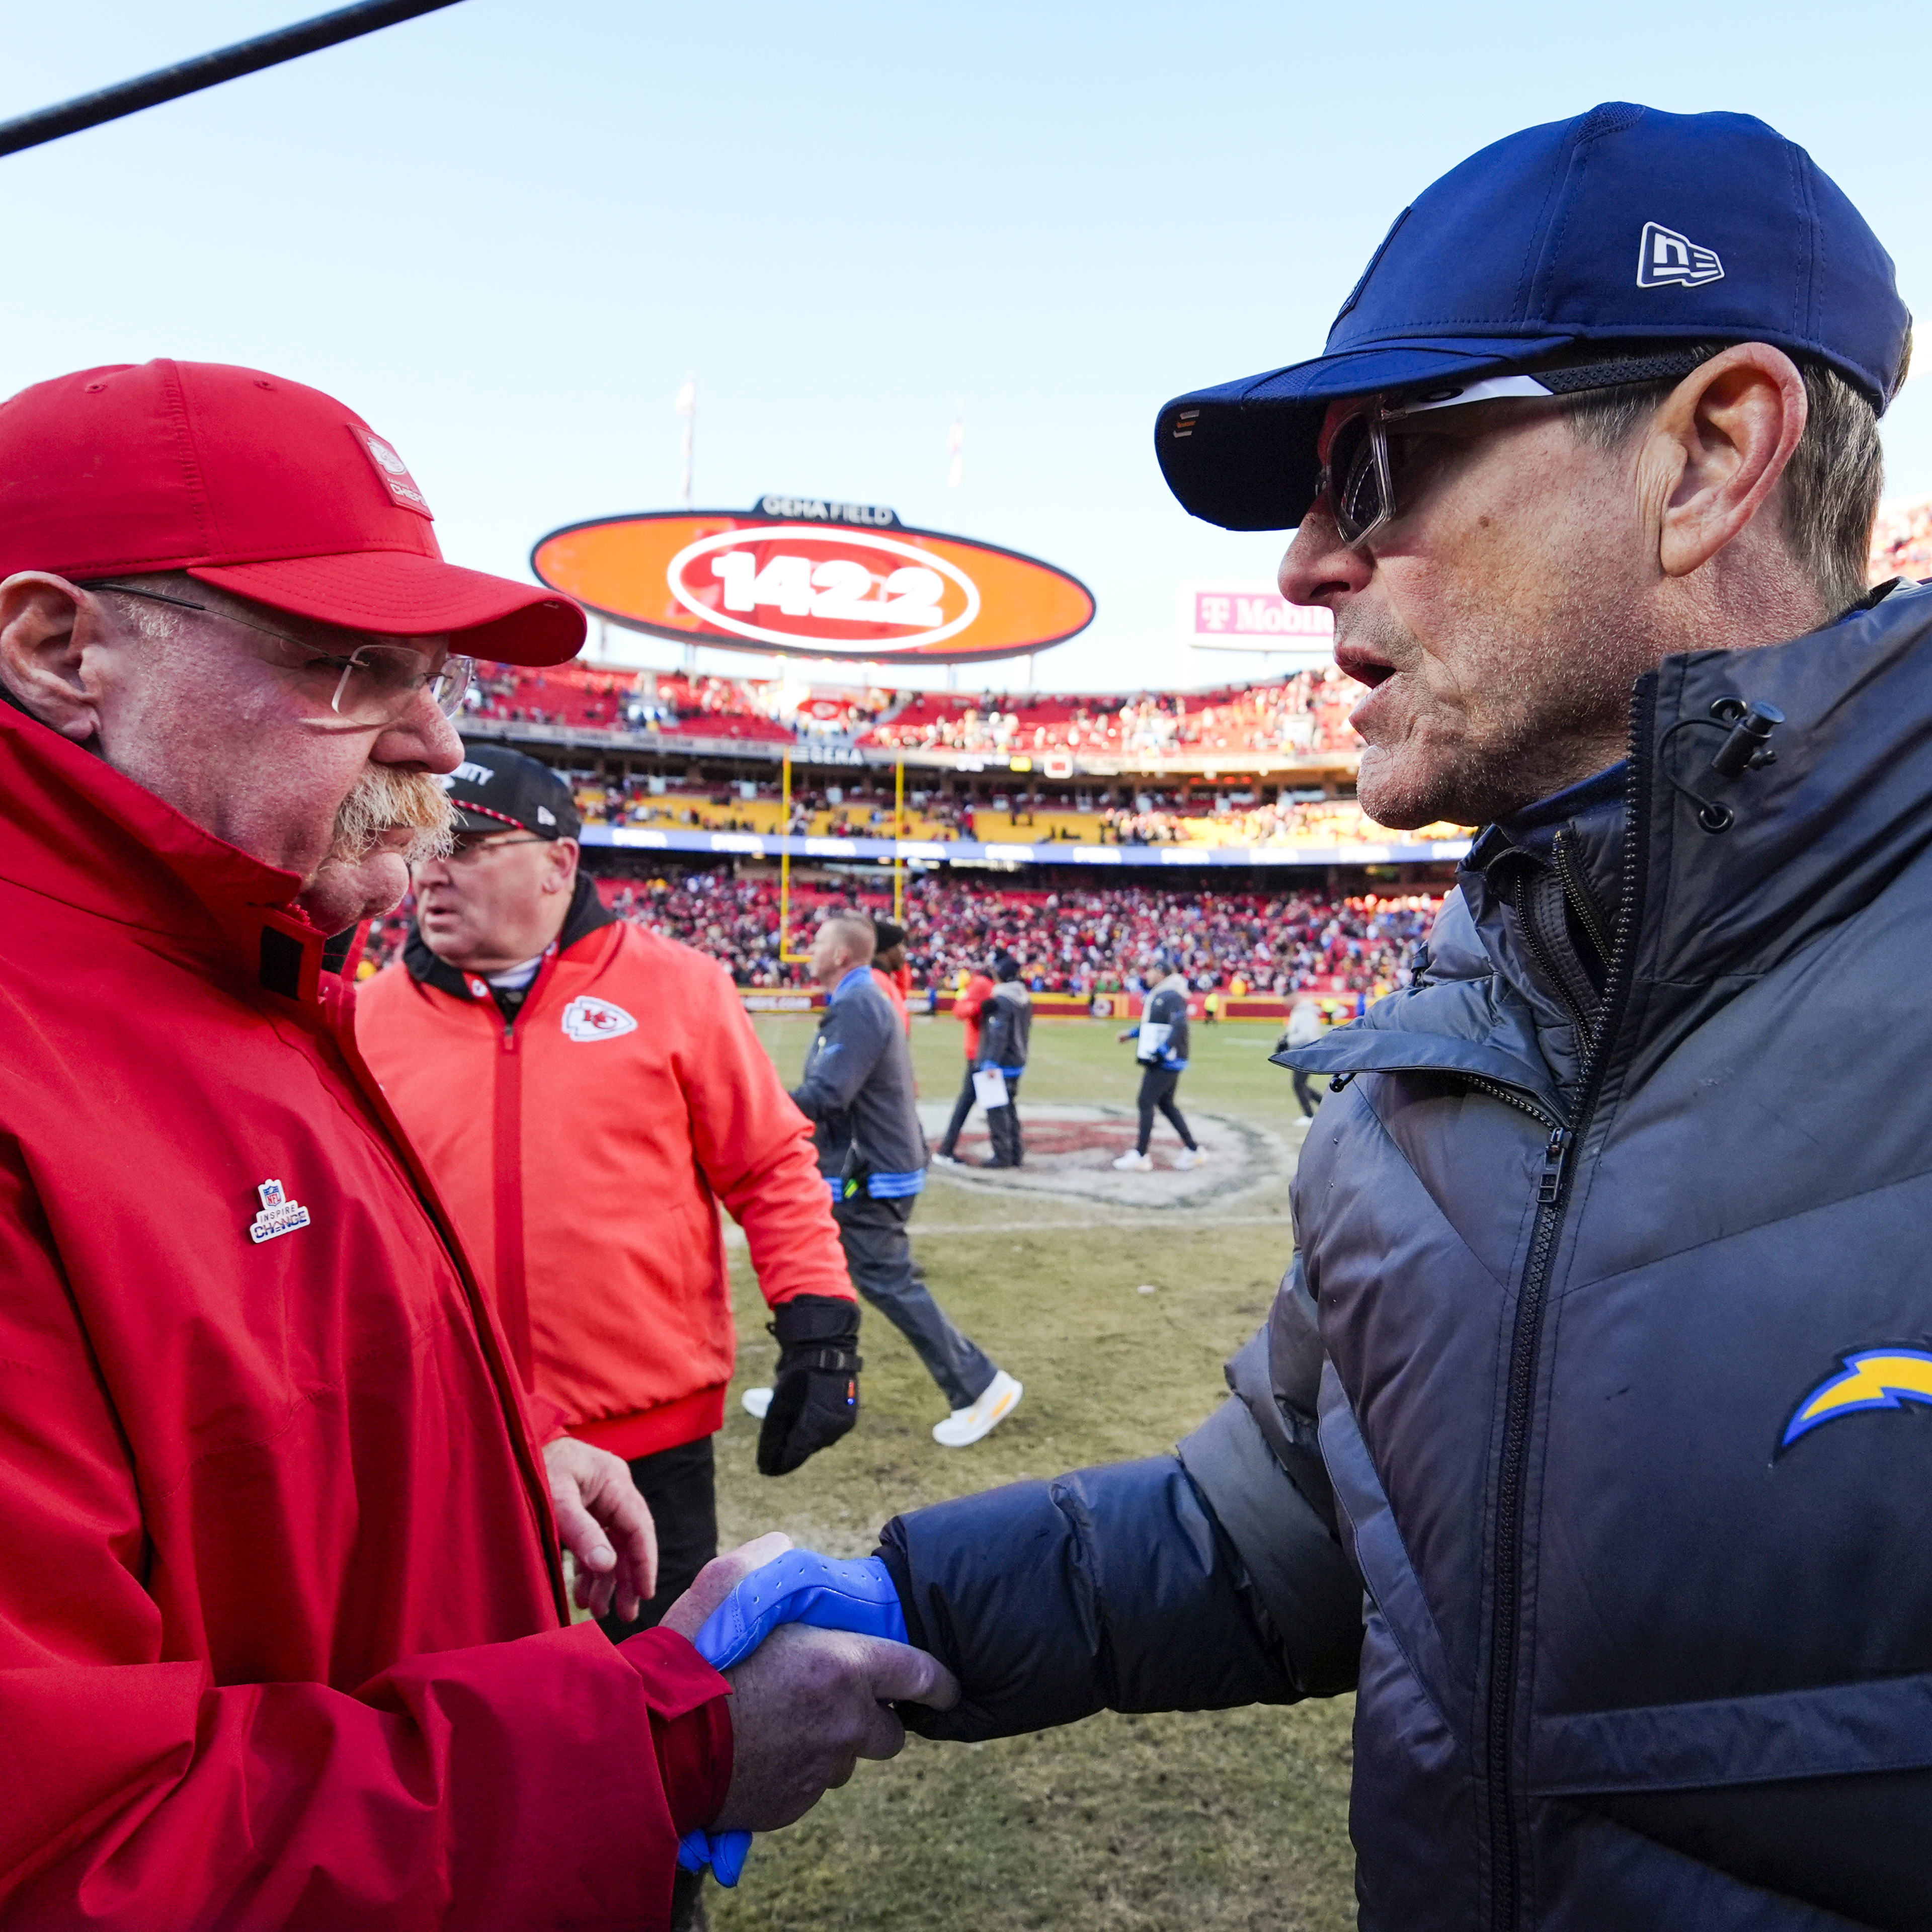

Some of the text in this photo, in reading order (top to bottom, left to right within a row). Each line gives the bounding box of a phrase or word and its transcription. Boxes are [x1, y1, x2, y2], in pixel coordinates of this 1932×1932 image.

[762, 496, 894, 526] GEHA FIELD
[267, 1193, 281, 1204] NFL
[254, 1211, 307, 1238] CHANGE
[260, 1204, 295, 1224] INSPIRE
